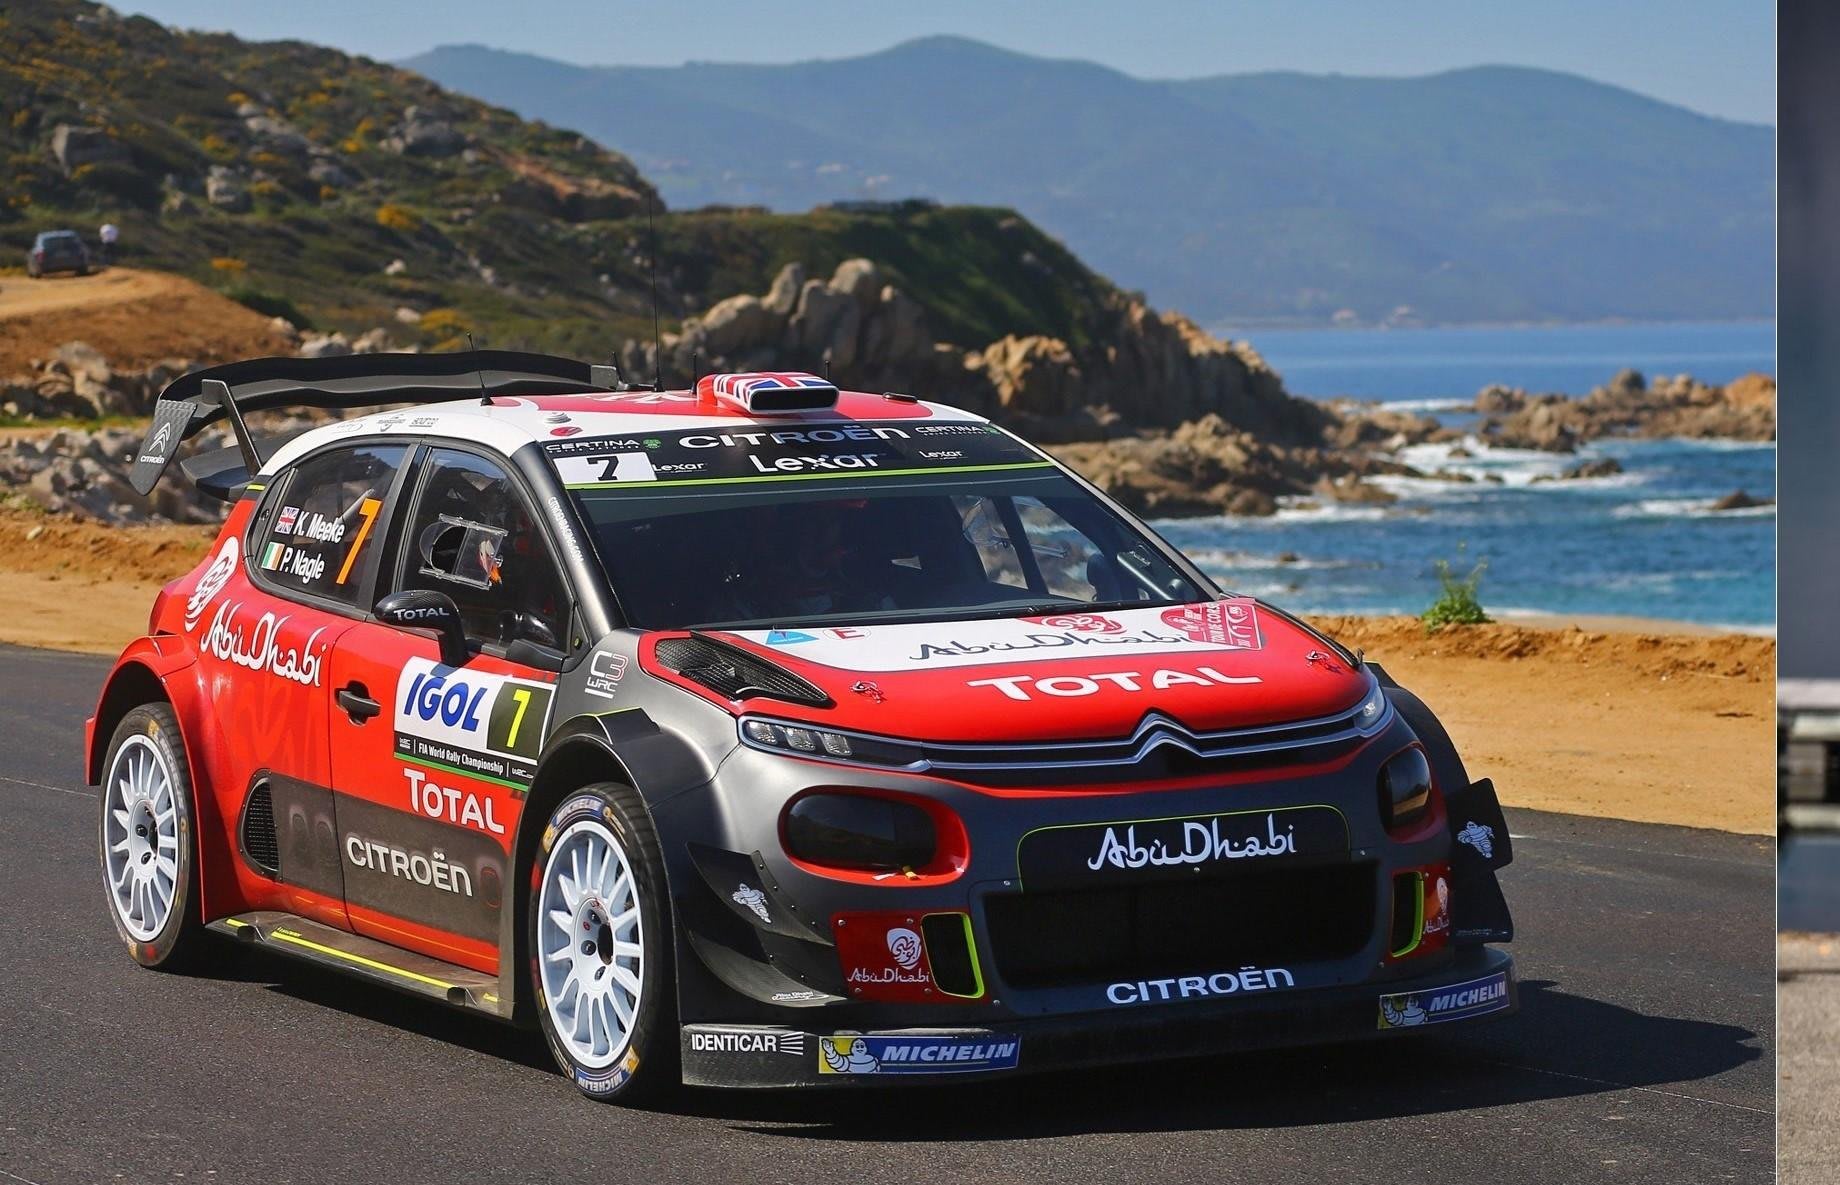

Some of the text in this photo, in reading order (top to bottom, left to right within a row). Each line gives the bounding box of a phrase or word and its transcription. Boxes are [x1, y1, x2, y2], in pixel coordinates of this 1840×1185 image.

[546, 439, 640, 451] CERTINA
[918, 450, 963, 458] Lexar
[587, 455, 620, 481] 7
[652, 463, 704, 472] Lexar
[749, 453, 879, 473] Lexar
[293, 510, 346, 543] K. Meeke
[336, 498, 382, 584] 7
[279, 546, 325, 584] P. Nagle
[393, 607, 450, 621] TOTAL
[591, 650, 629, 681] C3
[587, 676, 618, 692] WRC
[966, 666, 1264, 701] TOTAL
[404, 673, 488, 732] IGOL
[506, 688, 531, 748] 7
[418, 742, 428, 754] FIA
[429, 746, 445, 760] World
[446, 750, 460, 765] Rally
[461, 754, 504, 776] Championship
[403, 768, 505, 834] TOTAL
[1429, 980, 1506, 1012] MICHELIN
[691, 1033, 777, 1052] IDENTICAR
[881, 1043, 1016, 1062] MICHELIN
